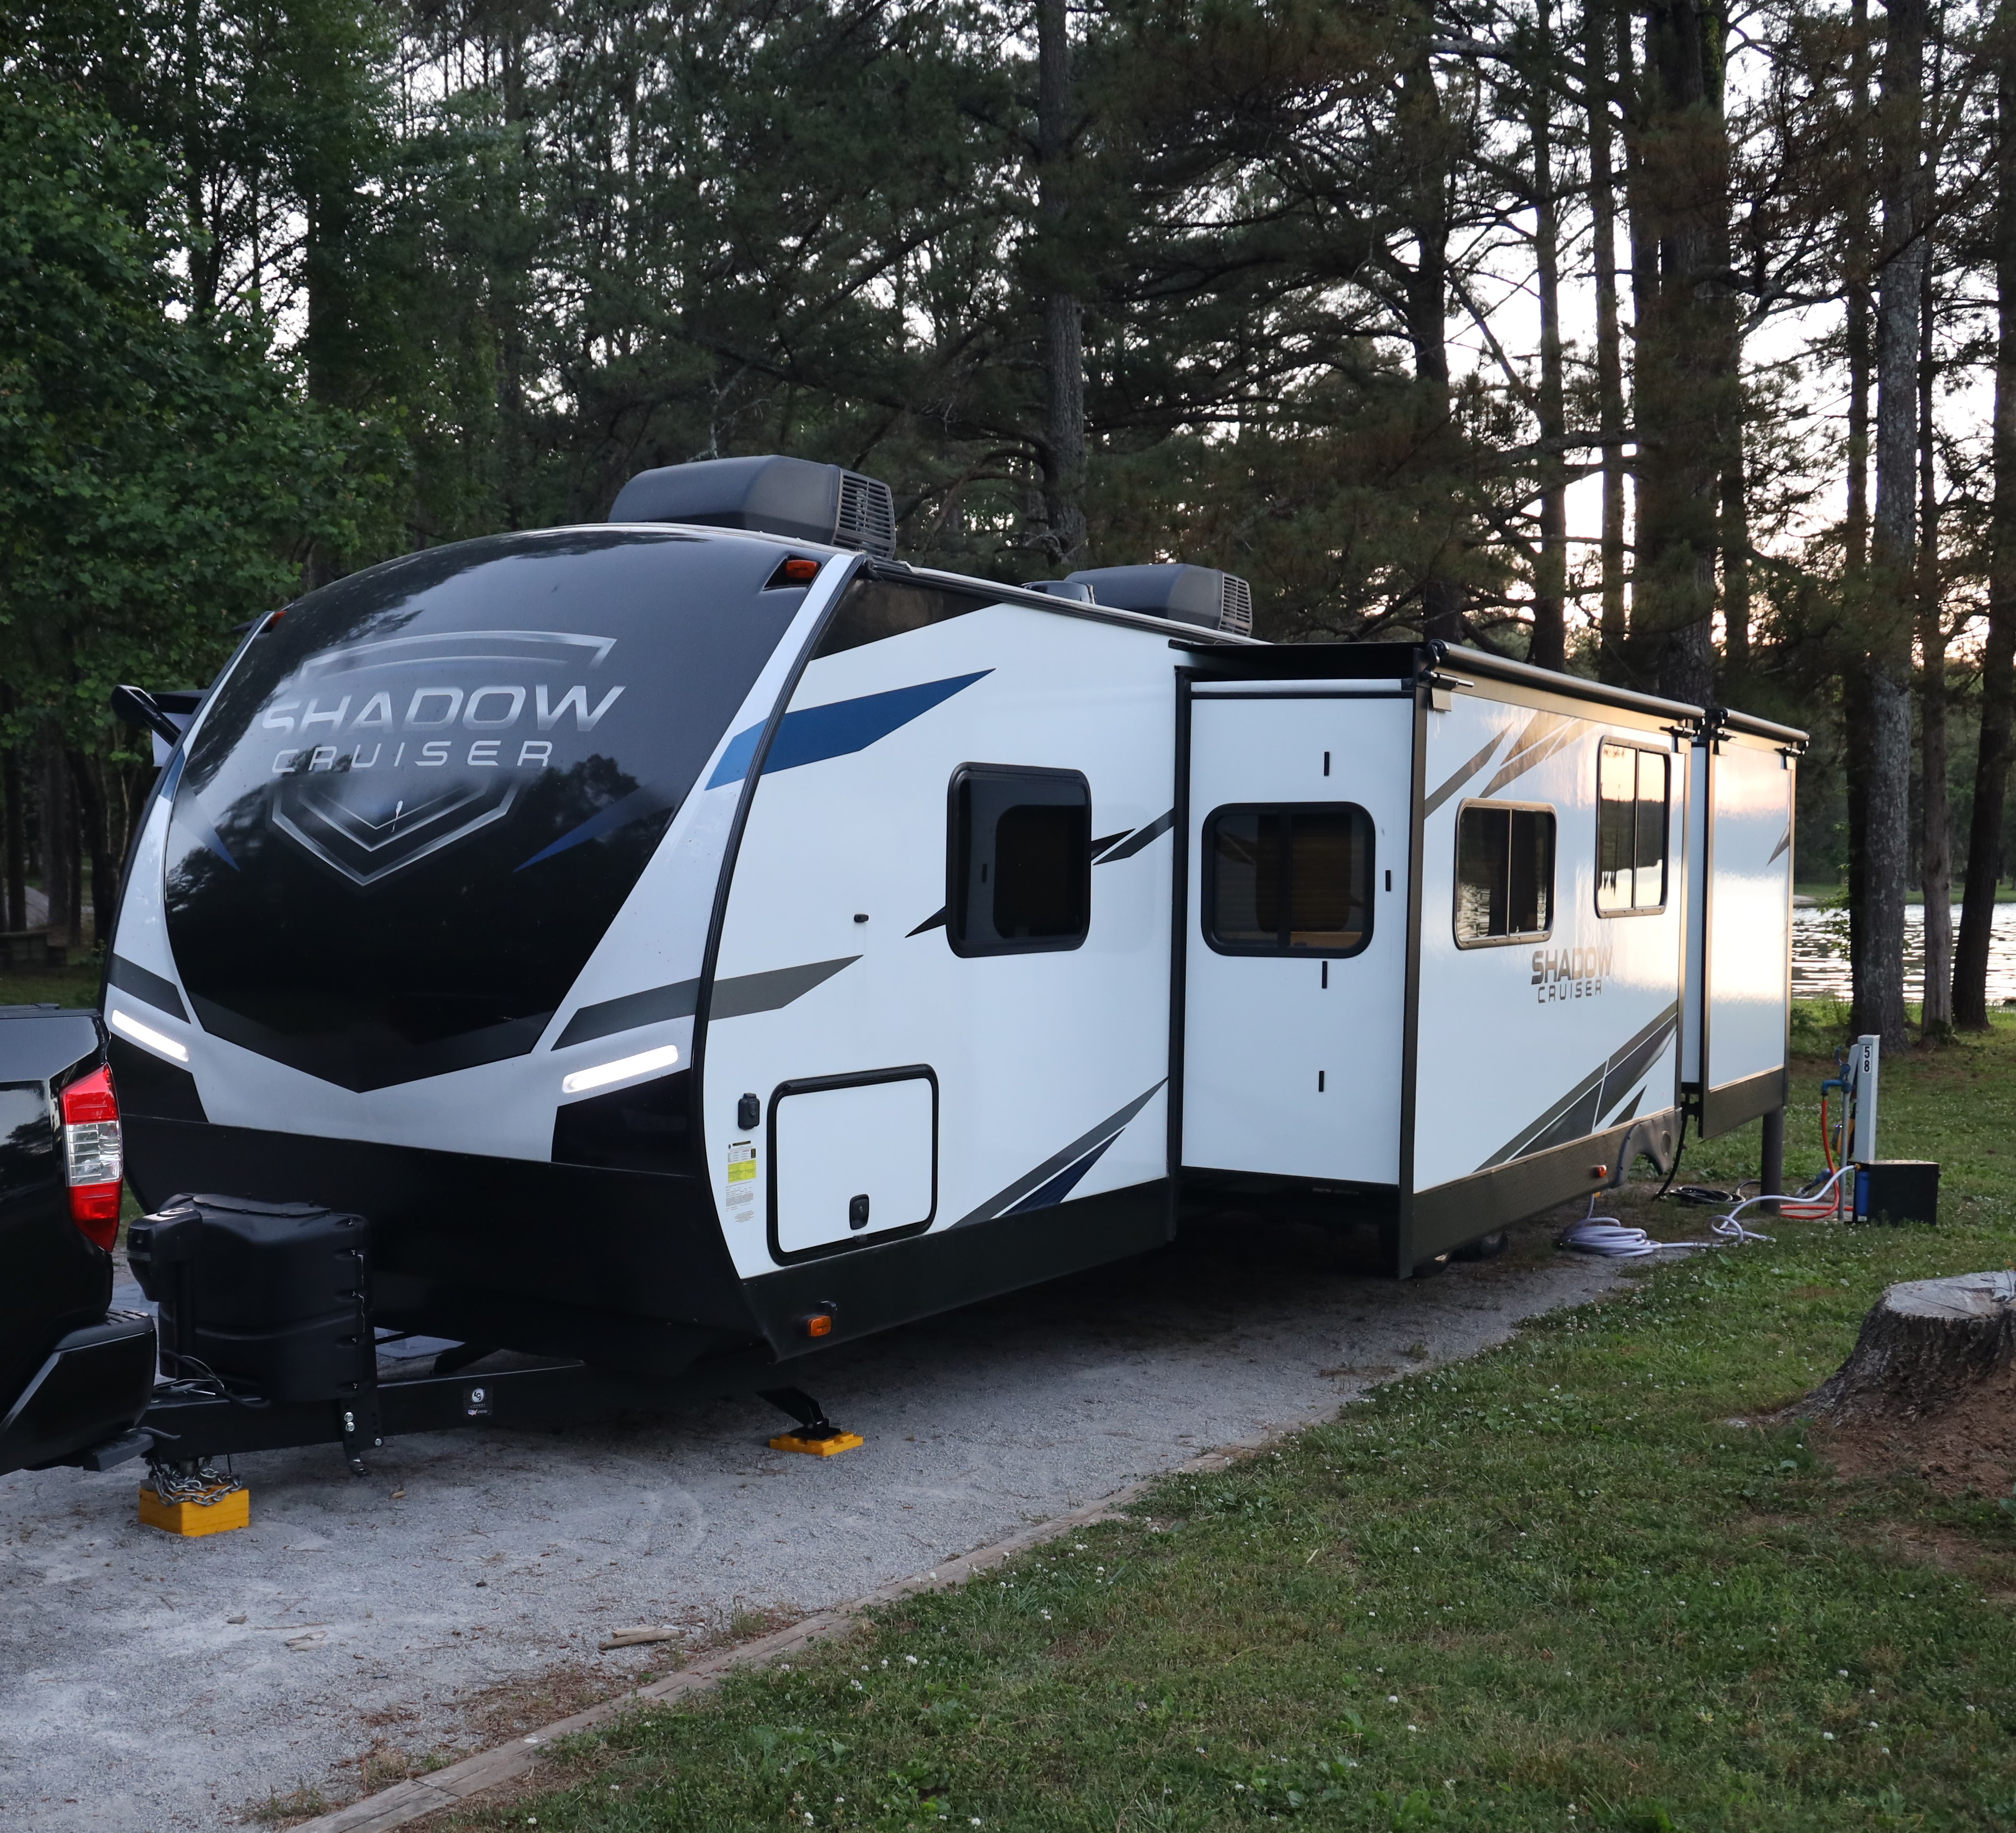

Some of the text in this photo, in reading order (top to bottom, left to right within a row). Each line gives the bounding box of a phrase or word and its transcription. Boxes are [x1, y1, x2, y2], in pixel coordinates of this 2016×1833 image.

[262, 685, 626, 736] SHADOW
[272, 740, 553, 773] CRUISER
[1531, 945, 1613, 985] SHADOW
[1538, 979, 1602, 1003] CRUISER
